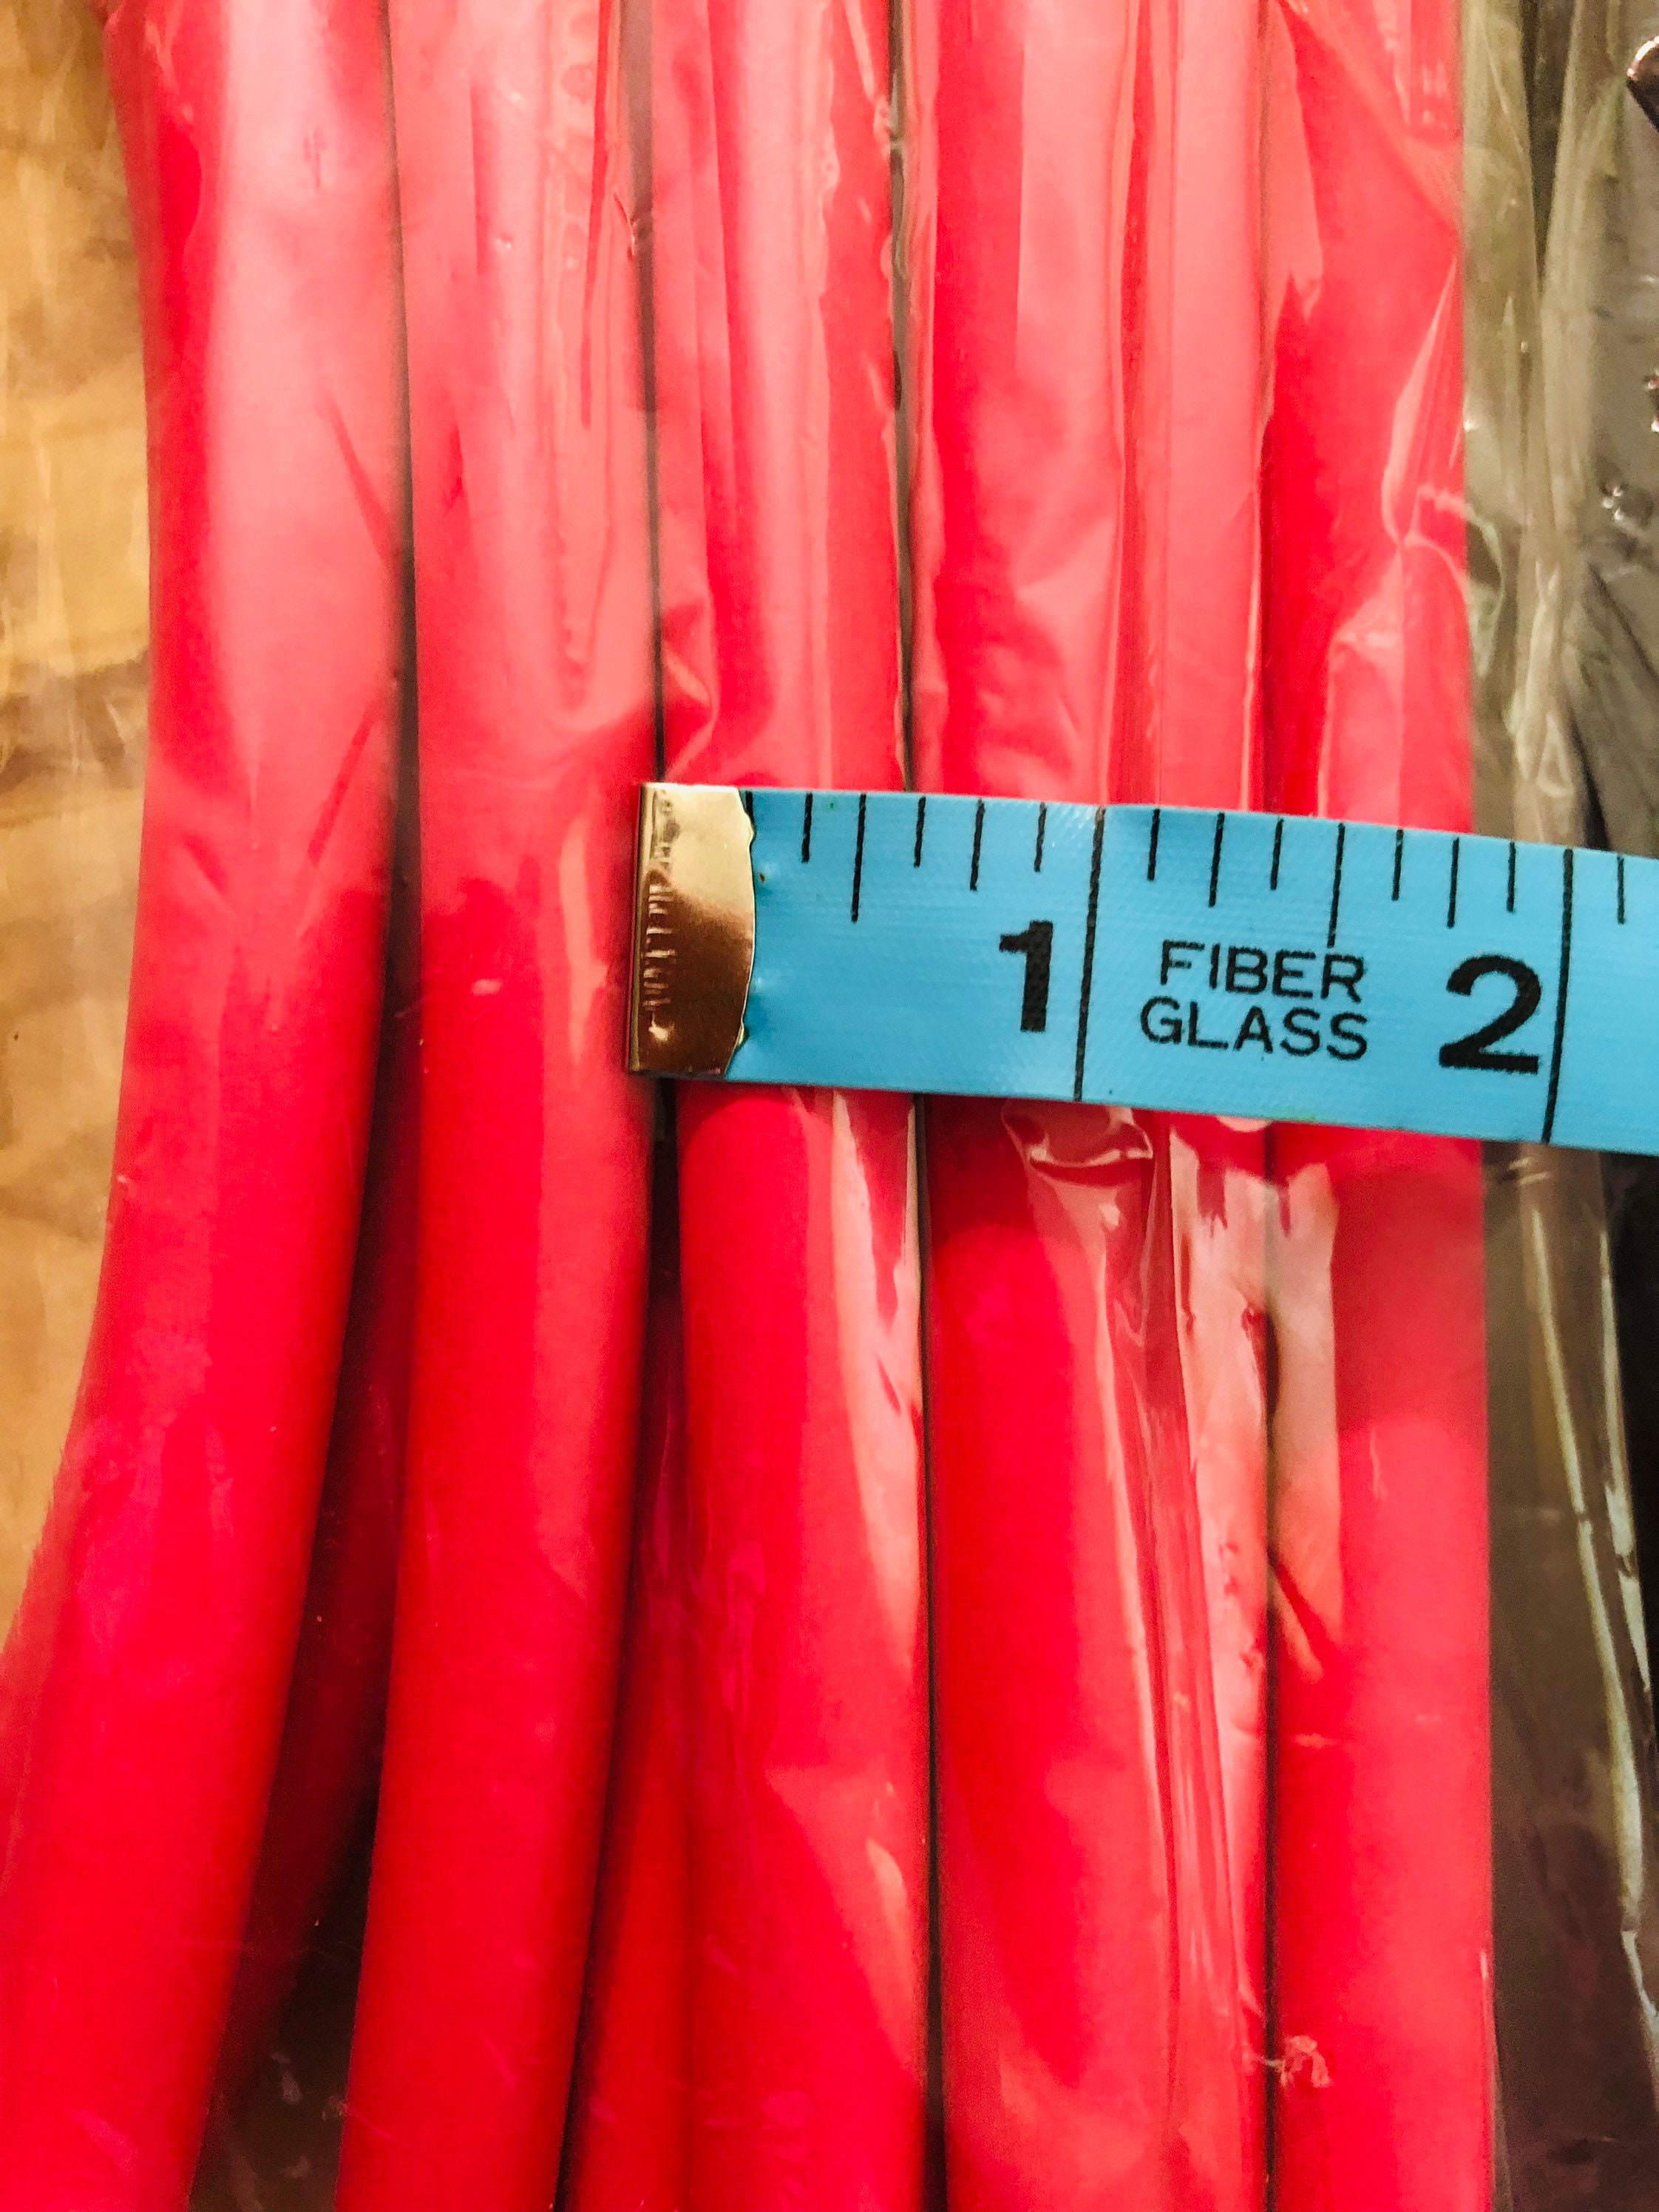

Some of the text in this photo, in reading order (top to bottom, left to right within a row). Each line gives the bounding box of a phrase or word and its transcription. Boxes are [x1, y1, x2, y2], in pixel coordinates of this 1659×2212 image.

[998, 919, 1054, 1034] 1
[1159, 939, 1365, 1004] FIBER
[1439, 954, 1542, 1076] 2
[1139, 995, 1368, 1062] GLASS
